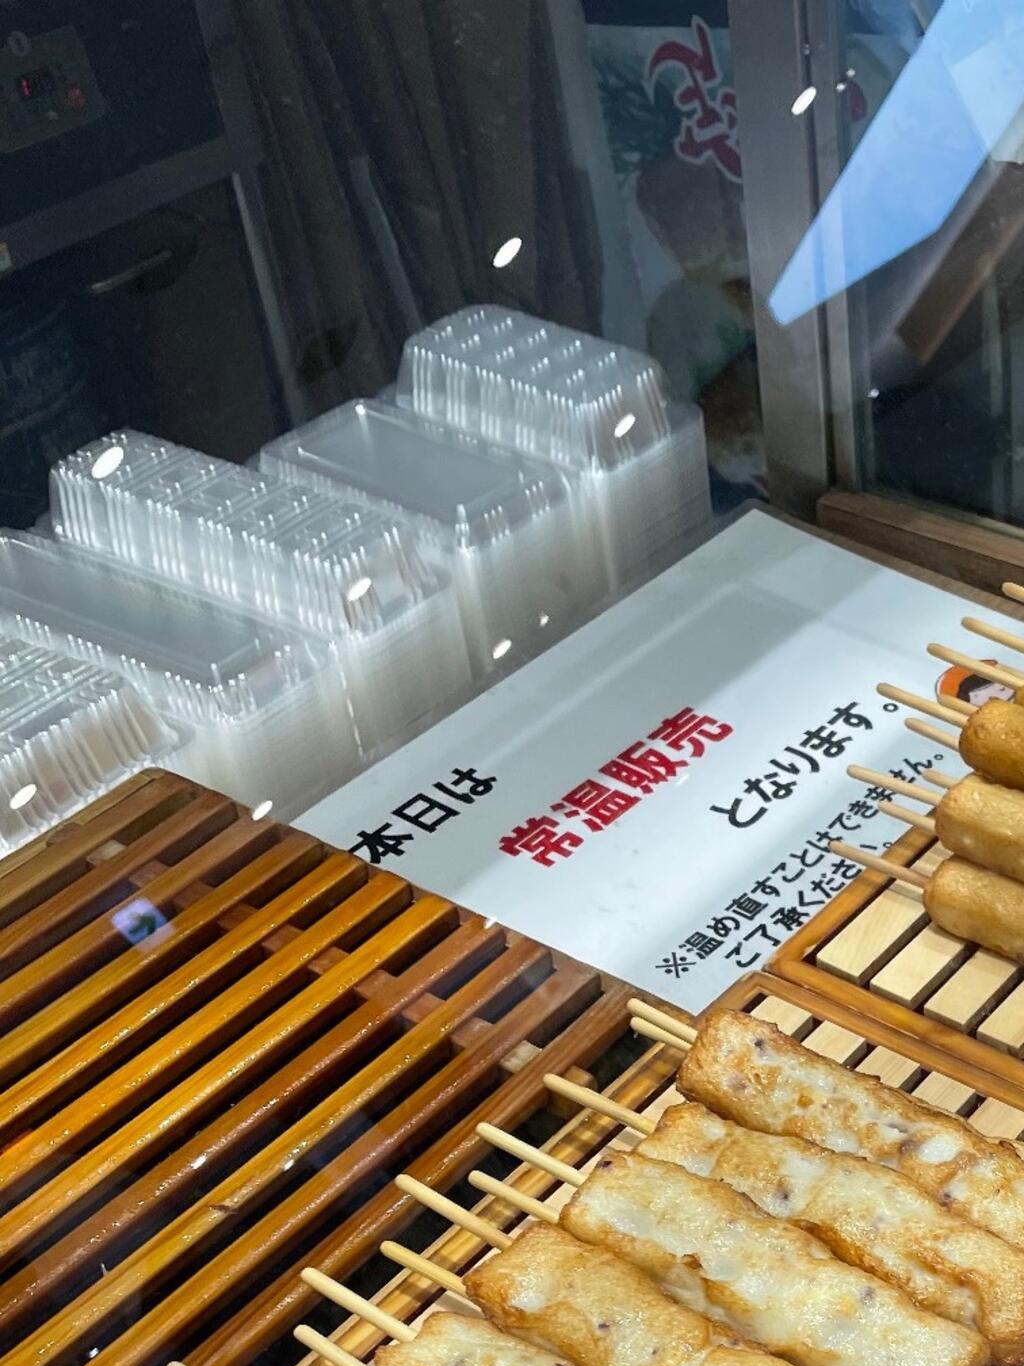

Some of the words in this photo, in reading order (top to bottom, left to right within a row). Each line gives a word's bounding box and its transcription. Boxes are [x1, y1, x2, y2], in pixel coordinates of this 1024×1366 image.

[349, 765, 498, 865] 本日は
[498, 706, 734, 867] 常温販売
[709, 700, 901, 830] となります。
